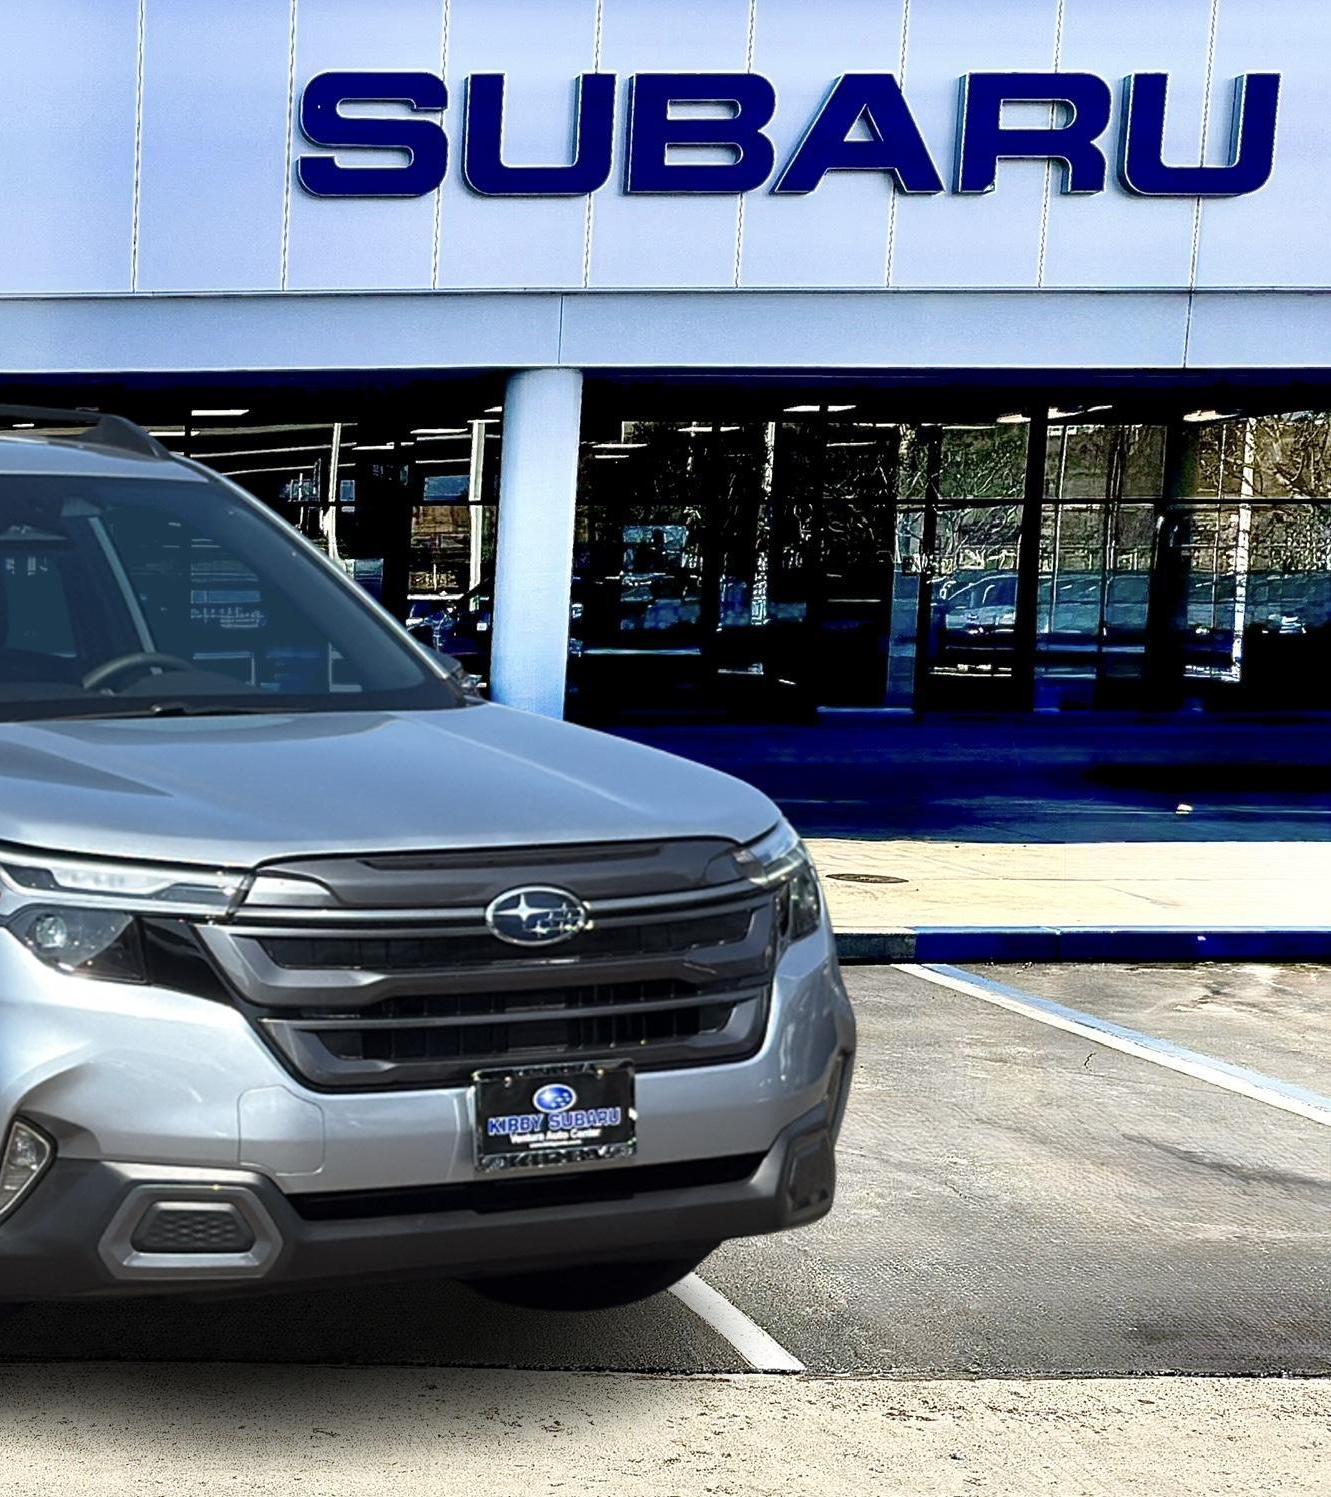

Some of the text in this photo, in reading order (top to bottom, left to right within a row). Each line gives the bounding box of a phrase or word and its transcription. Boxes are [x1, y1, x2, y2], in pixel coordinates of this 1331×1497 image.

[297, 71, 1279, 198] SUBARU
[488, 1107, 622, 1136] KIRBY SUBARU
[546, 1130, 570, 1141] Auto
[570, 1128, 602, 1139] Center
